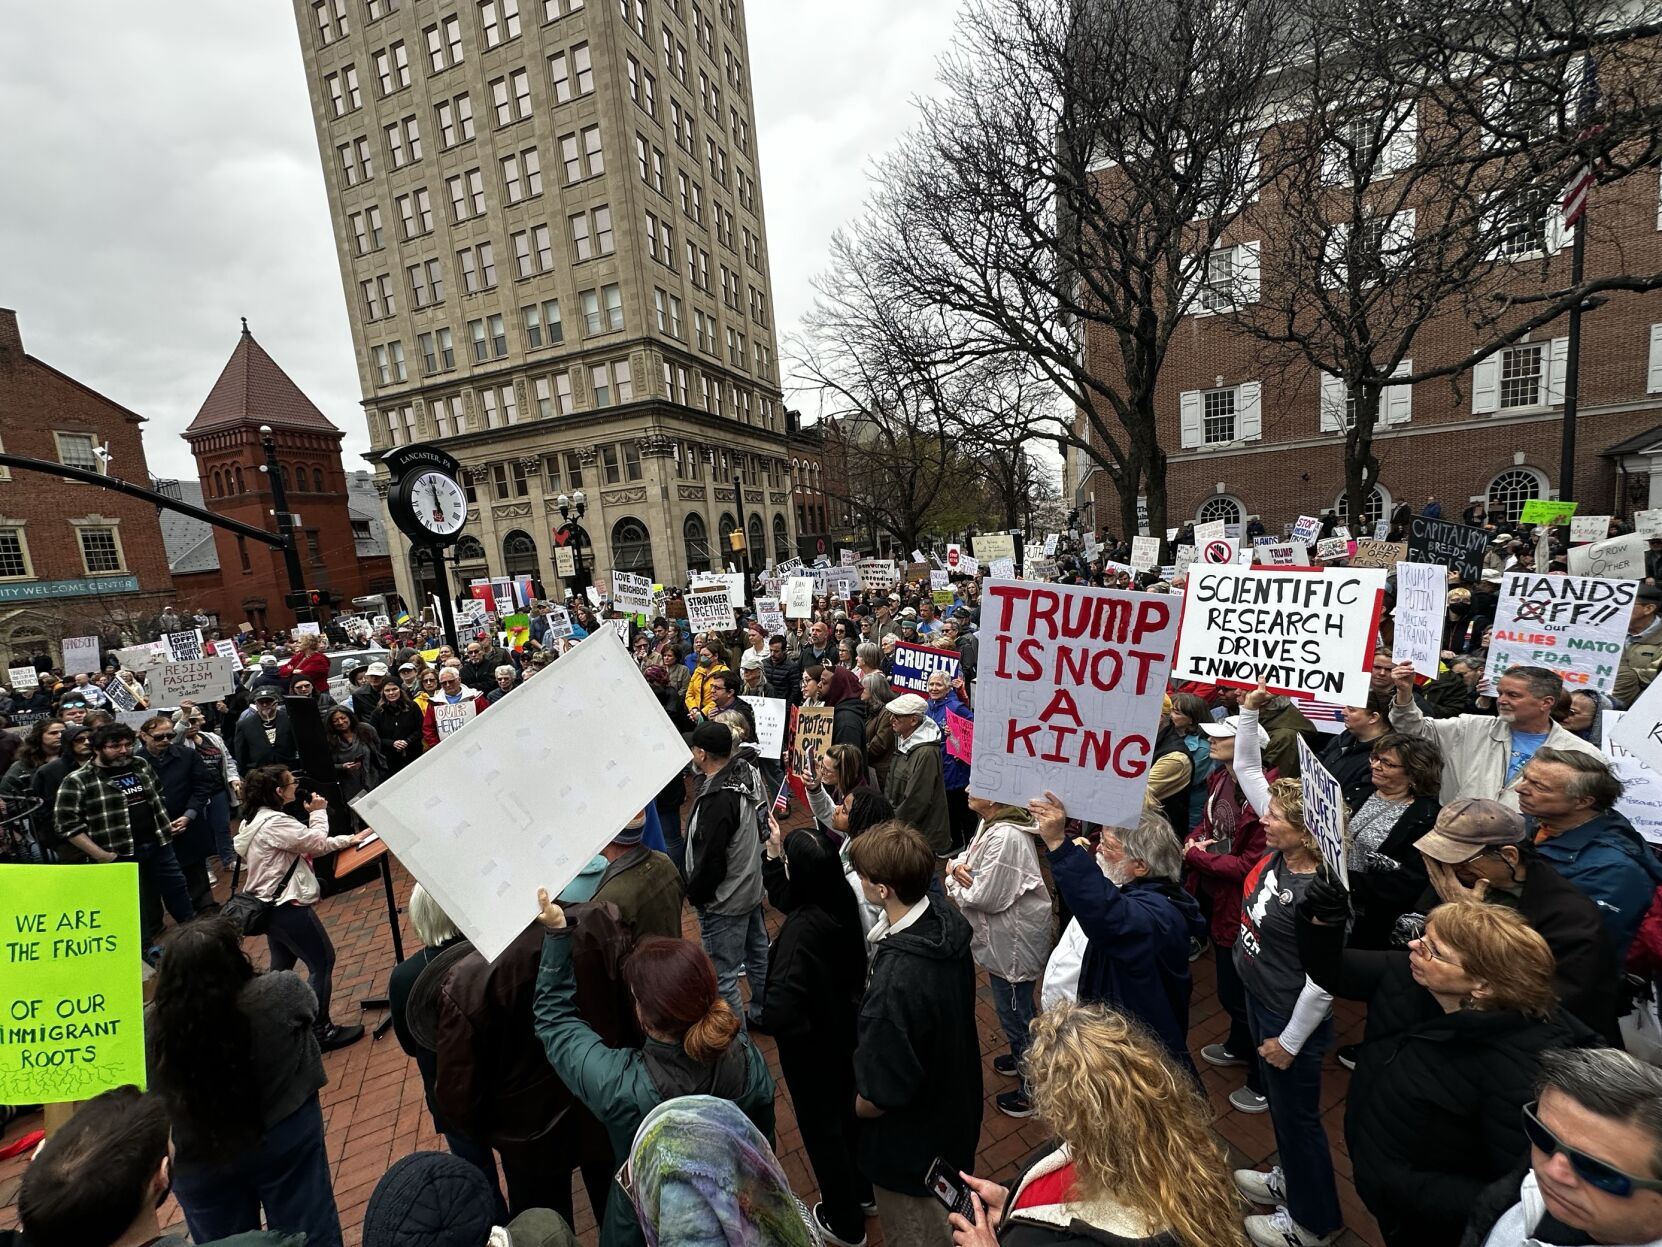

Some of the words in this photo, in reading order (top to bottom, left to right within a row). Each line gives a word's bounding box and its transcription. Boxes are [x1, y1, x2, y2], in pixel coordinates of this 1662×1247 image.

[399, 452, 441, 465] LANCASTER,
[442, 459, 451, 469] PA
[1024, 547, 1044, 559] RUTH
[1269, 548, 1293, 558] TRUMP
[1361, 541, 1400, 553] HANDS
[1367, 550, 1397, 561] OFF!
[1428, 541, 1467, 559] BREEDS
[614, 572, 631, 583] LOVE
[634, 576, 650, 587] YOUR
[1398, 564, 1434, 589] TRUMP
[23, 583, 85, 595] WELCOME
[88, 580, 132, 591] CENTER
[618, 583, 648, 596] NEIGHBOR
[1196, 574, 1361, 608] SCIENTIFIC
[1509, 576, 1636, 606] HANDS
[614, 594, 622, 604] AS
[624, 595, 652, 608] YOURSELF
[688, 594, 728, 606] STRONGER
[1404, 587, 1434, 611] PUTIN
[690, 604, 730, 618] TOGETHER
[989, 586, 1170, 645] TRUMP
[1402, 611, 1428, 627] MAKING
[1513, 598, 1620, 627] OFF!!
[1206, 607, 1344, 638] RESEARCH
[1217, 635, 1321, 664] DRIVES
[1494, 630, 1557, 646] ALLIES
[1567, 637, 1620, 654] NATO
[895, 648, 959, 677] CRUELTY
[994, 635, 1045, 682] IS
[1054, 645, 1166, 696] NOT
[1532, 650, 1572, 665] FDA
[165, 661, 213, 676] RESIST
[921, 671, 928, 680] IS
[1189, 656, 1345, 694] INNOVATION
[163, 672, 213, 686] FASCISM
[893, 674, 929, 692] UN-AME
[179, 688, 200, 697] Silent
[436, 704, 466, 720] OUR
[1038, 688, 1084, 727] A
[797, 714, 832, 736] PROTECT
[1006, 718, 1151, 779] KING
[1304, 806, 1342, 875] LIBERTY
[16, 914, 47, 933] WE
[56, 910, 102, 932] ARE
[6, 942, 40, 962] THE
[11, 1000, 43, 1020] OF
[56, 994, 105, 1018] OUR
[22, 1045, 96, 1070] ROOTS
